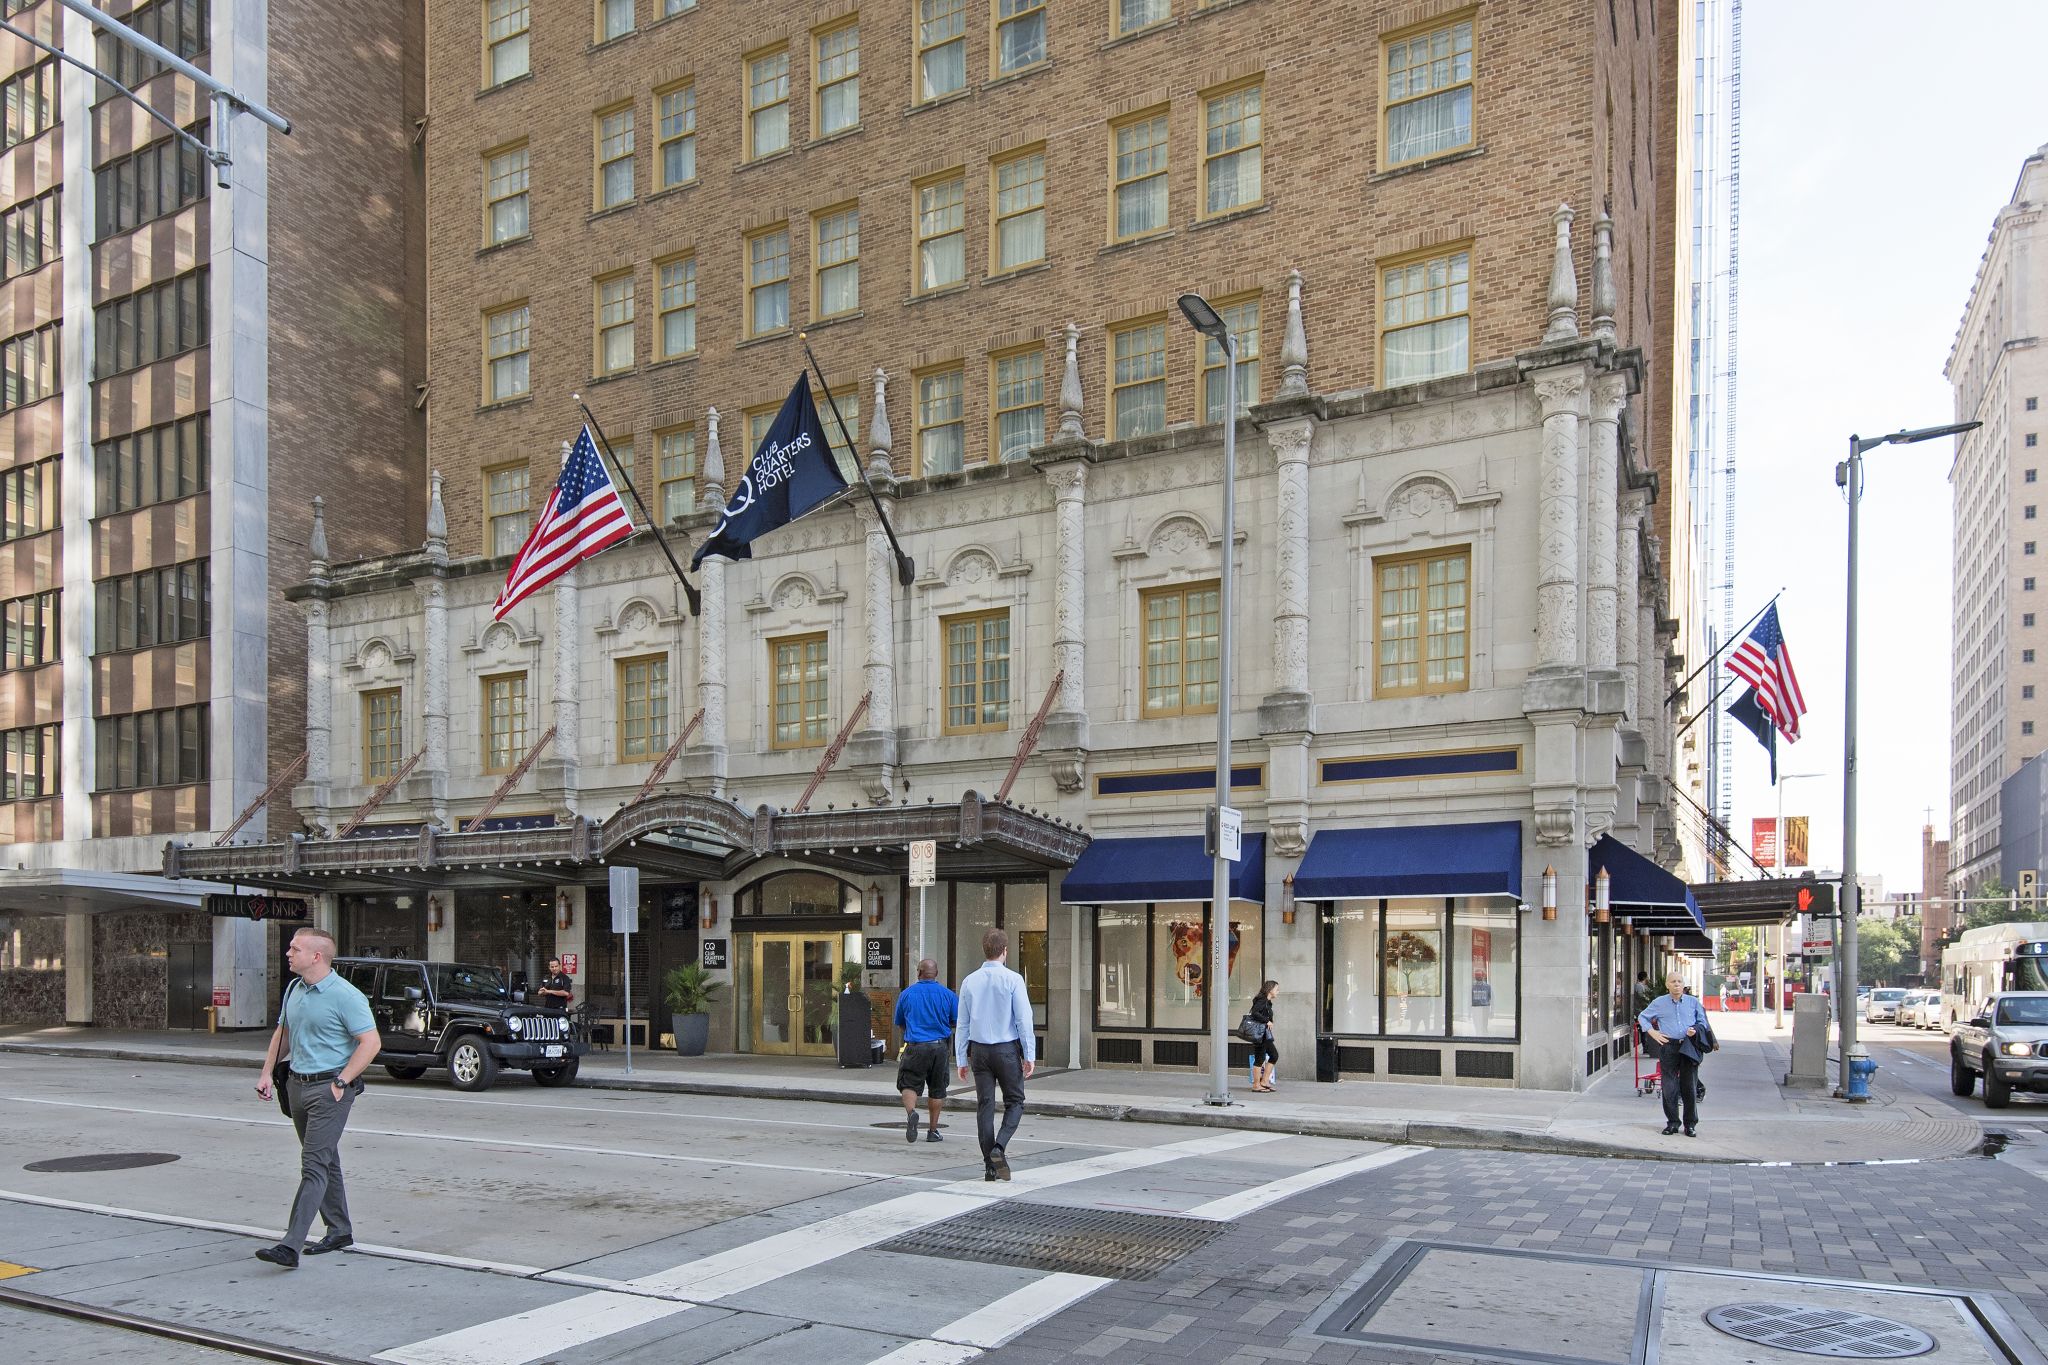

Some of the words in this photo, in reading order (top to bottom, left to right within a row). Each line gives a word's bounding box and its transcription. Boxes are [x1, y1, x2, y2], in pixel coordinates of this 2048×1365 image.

[752, 440, 779, 471] CLUB
[755, 432, 812, 483] QUARTERS
[758, 462, 795, 495] HOTEL
[272, 900, 306, 917] BISTRO
[704, 942, 716, 951] CQ
[867, 941, 880, 950] CQ
[2034, 943, 2043, 953] 6
[563, 954, 576, 964] FDC
